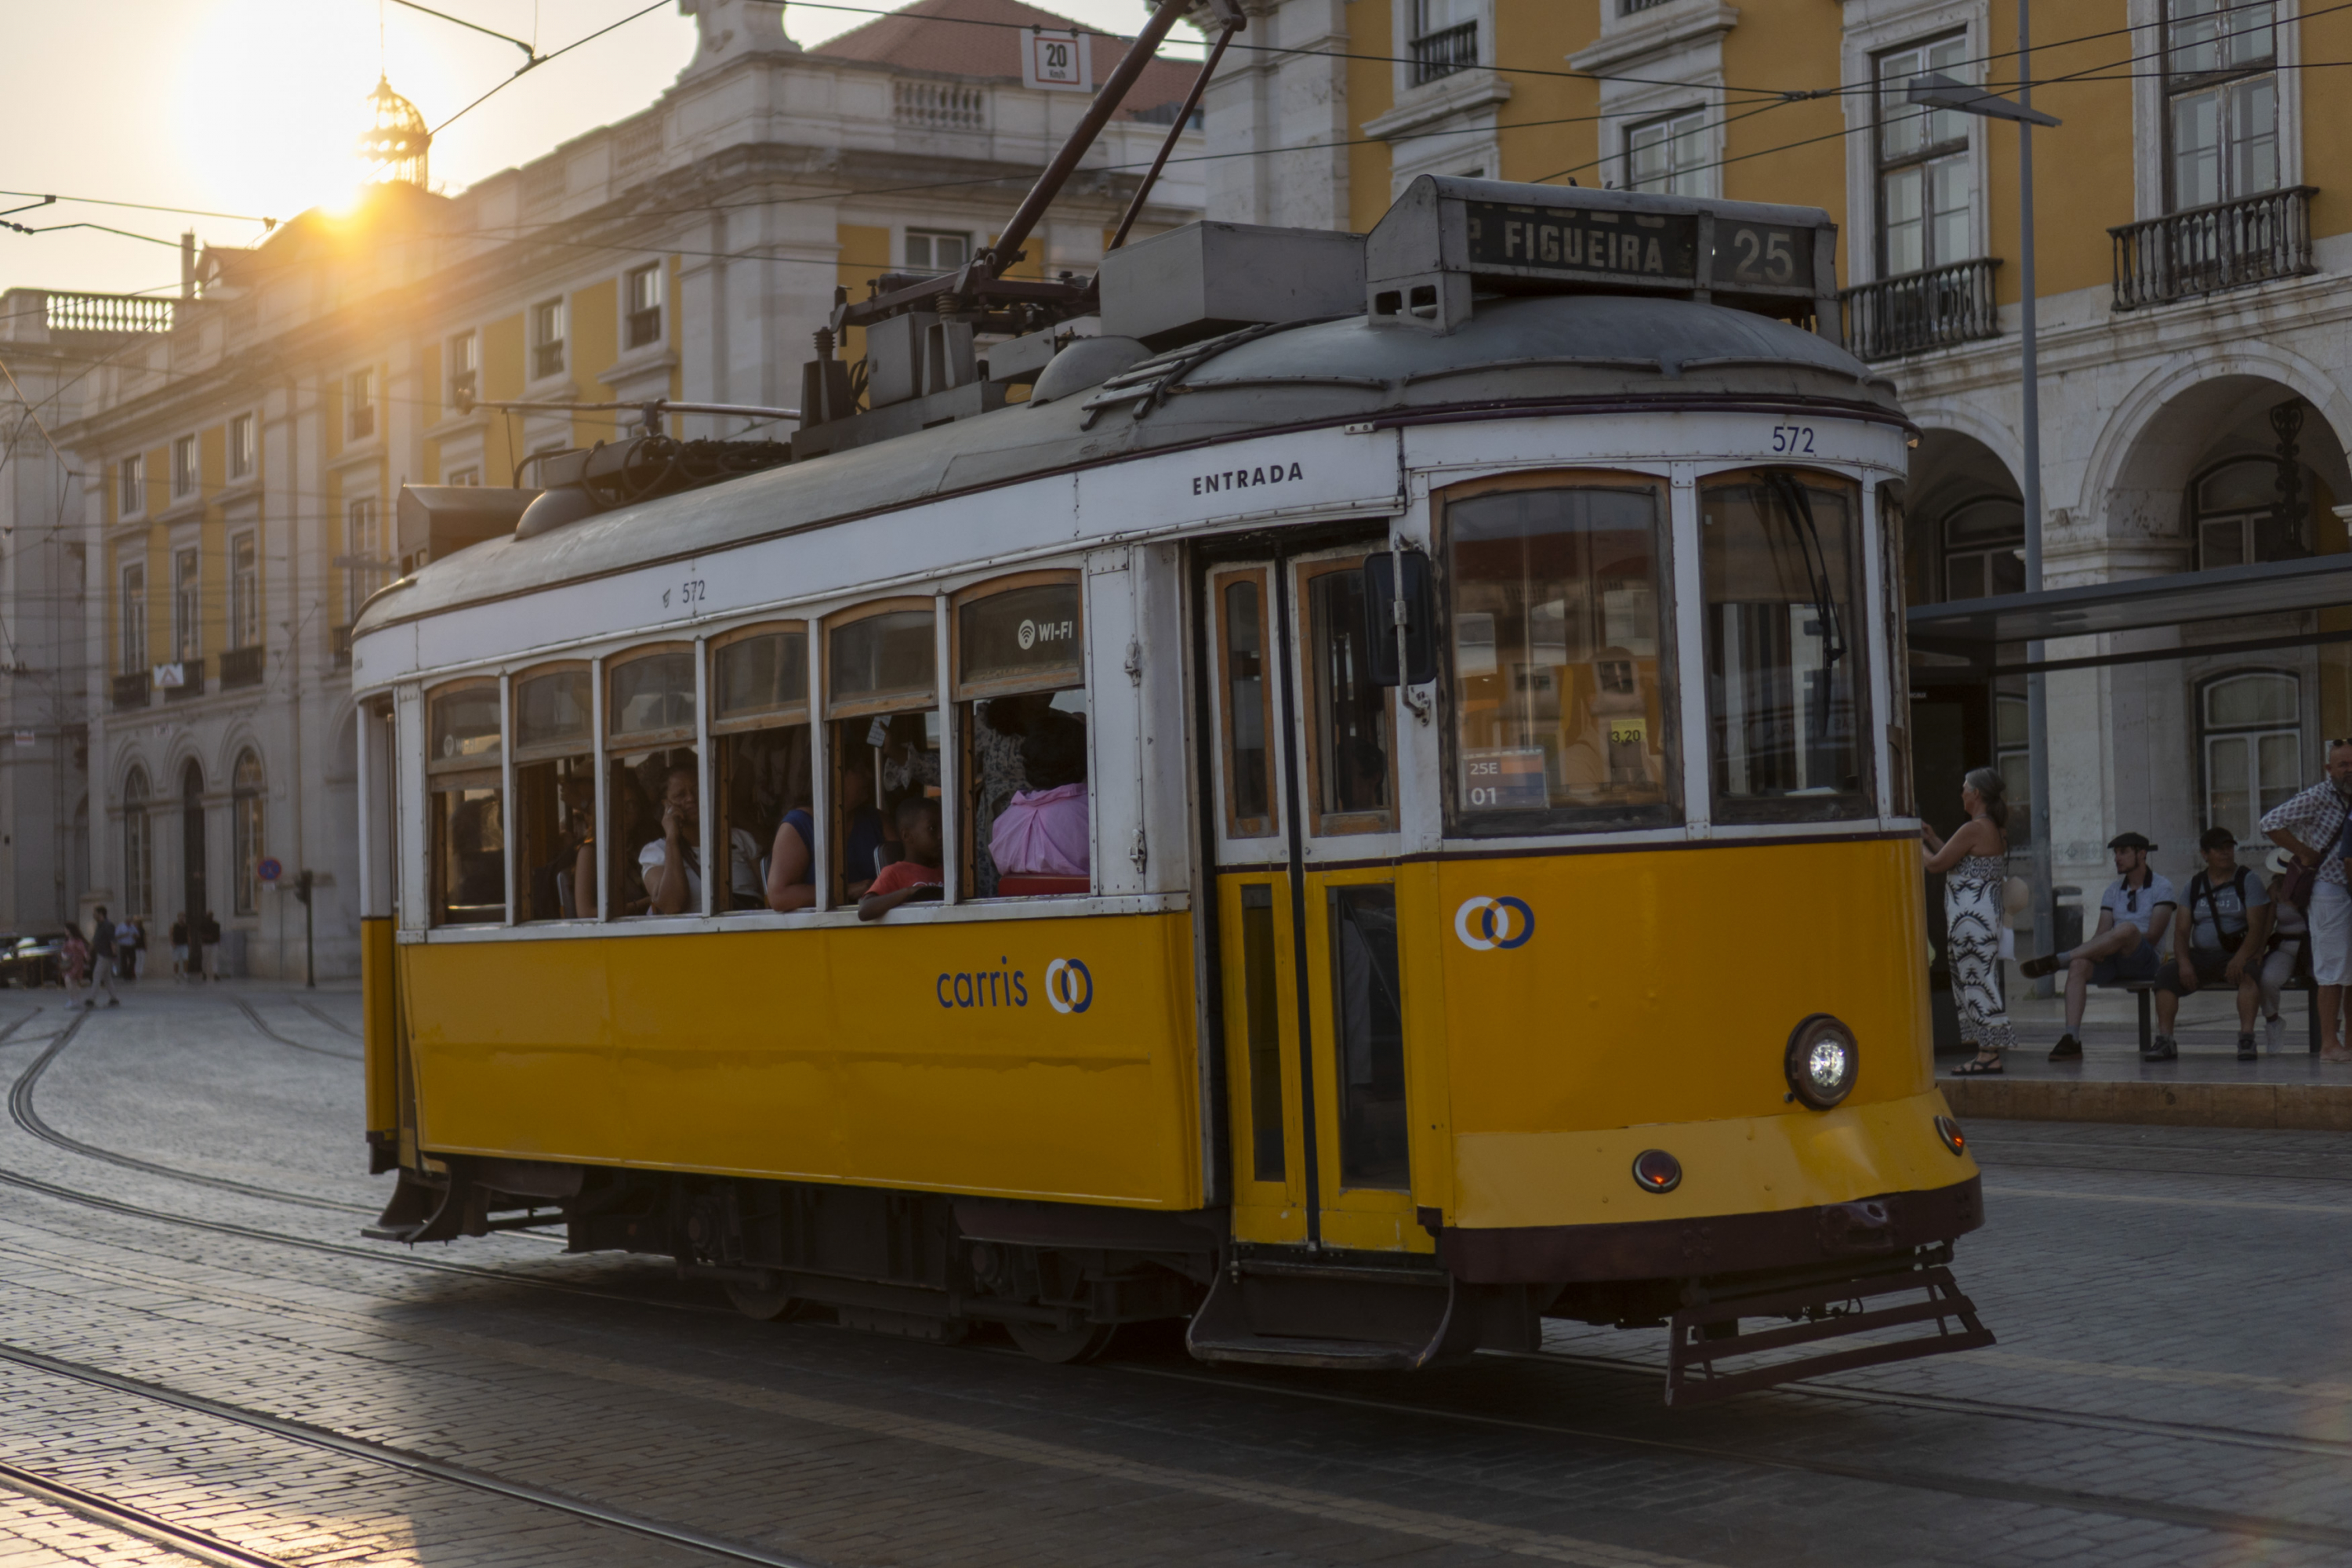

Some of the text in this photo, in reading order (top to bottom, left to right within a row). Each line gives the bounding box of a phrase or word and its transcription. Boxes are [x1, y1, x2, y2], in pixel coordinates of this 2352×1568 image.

[1046, 43, 1067, 67] 20
[1049, 69, 1066, 79] Km/h
[1504, 220, 1664, 274] FIGUEIRA
[1733, 228, 1793, 284] 25
[1773, 426, 1814, 453] 572
[1192, 462, 1303, 496] ENTRADA
[682, 579, 706, 604] 572
[1038, 620, 1073, 642] WI-FI
[1612, 729, 1641, 743] 3,20
[1469, 762, 1498, 775] 25E
[1471, 787, 1497, 805] 01
[936, 954, 1029, 1009] carris
